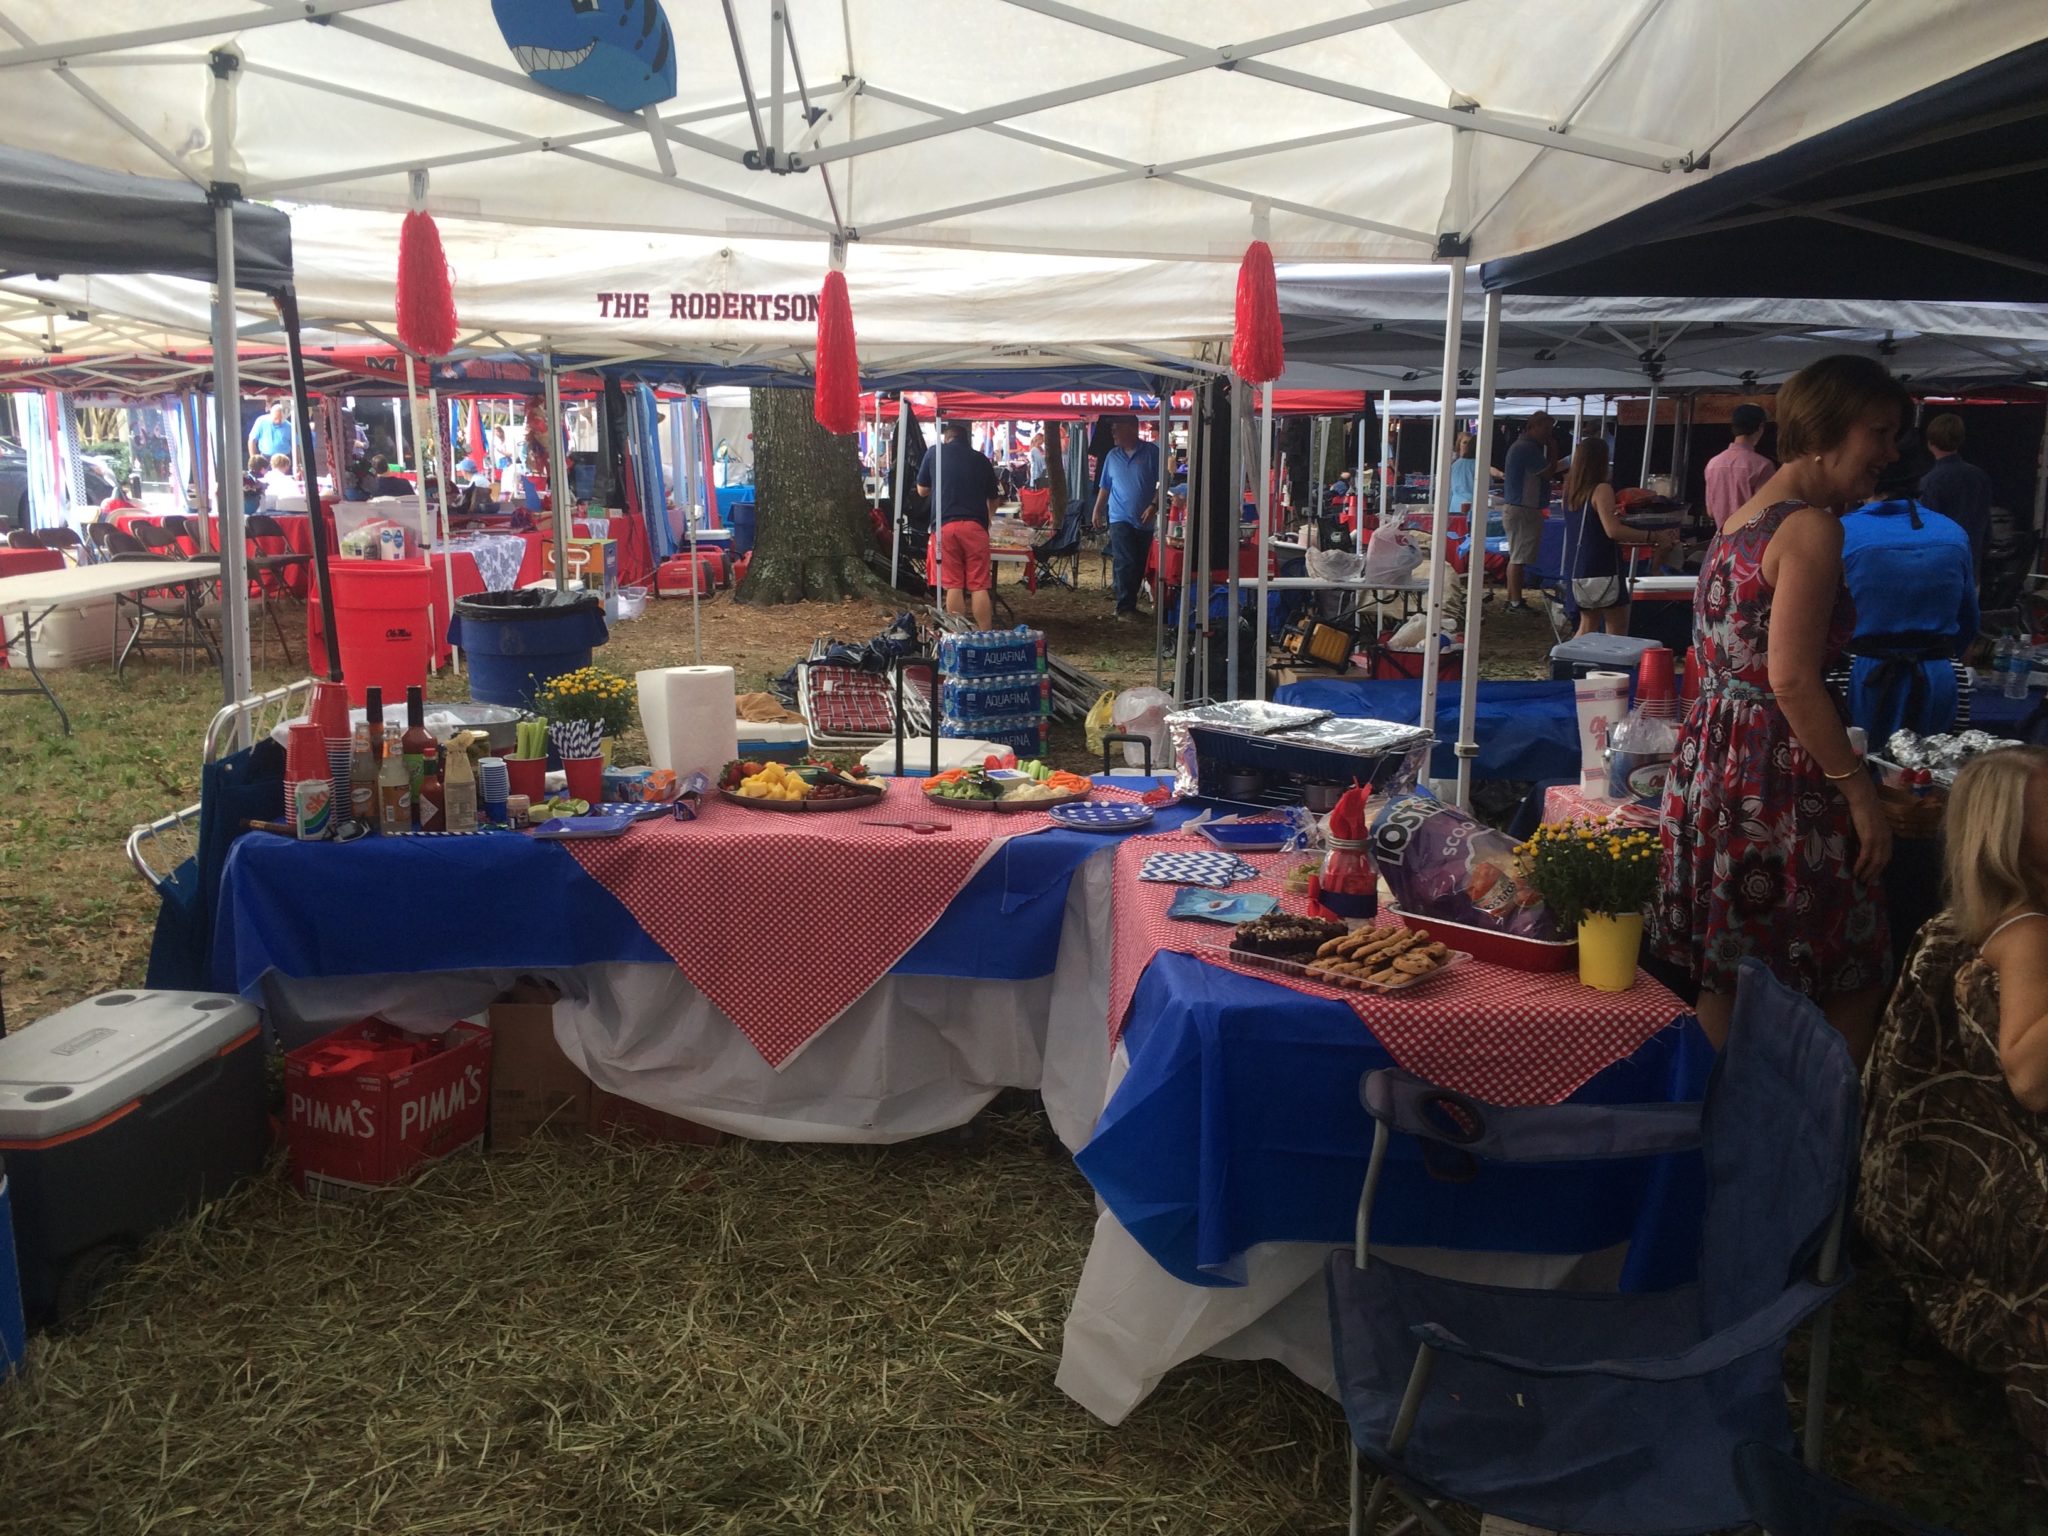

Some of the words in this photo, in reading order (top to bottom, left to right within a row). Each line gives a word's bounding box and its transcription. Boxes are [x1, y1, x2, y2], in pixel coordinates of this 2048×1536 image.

[597, 292, 649, 318] THE
[1061, 392, 1087, 407] OLE
[1091, 392, 1125, 407] MISS
[984, 649, 1028, 667] AQUAFINA
[985, 691, 1031, 709] AQUAFINA
[1443, 821, 1477, 856] SCOO
[400, 1064, 482, 1140] PIMM'S
[291, 1092, 375, 1139] PIMM'S
